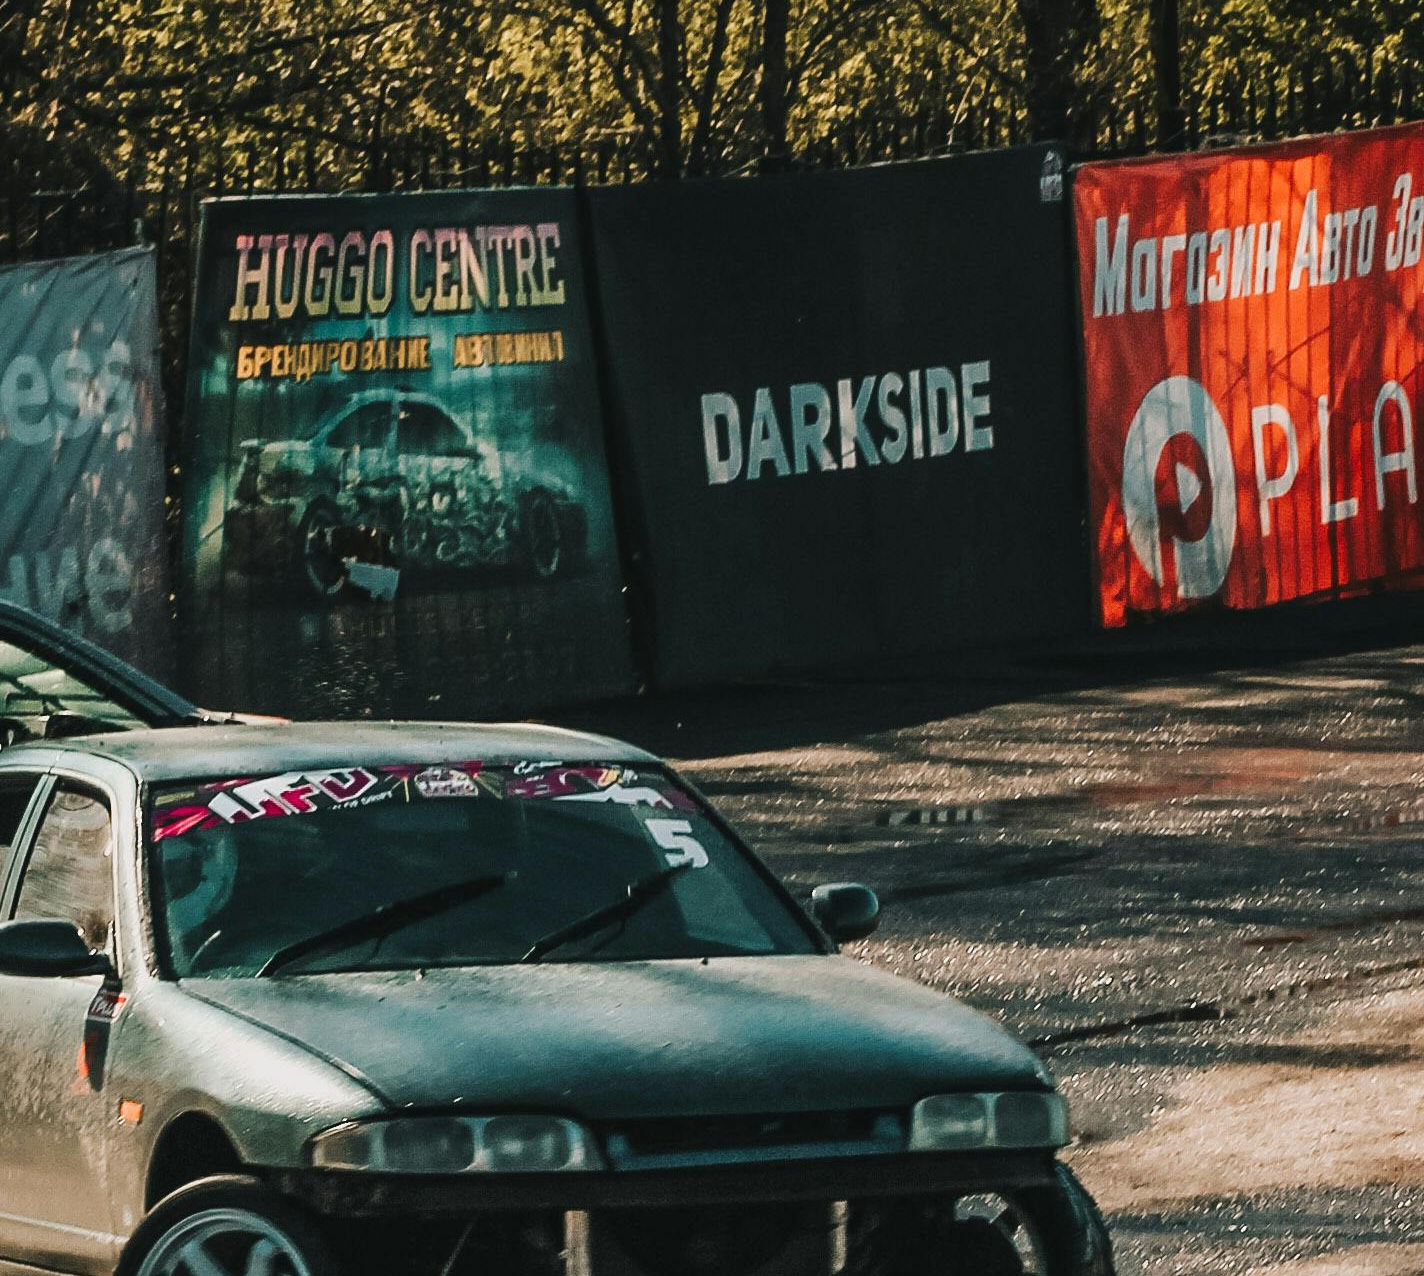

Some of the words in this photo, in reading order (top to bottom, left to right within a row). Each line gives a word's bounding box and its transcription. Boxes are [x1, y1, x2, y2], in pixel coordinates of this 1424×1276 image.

[228, 228, 395, 322] HUGGO
[409, 222, 566, 315] CENTRE
[1092, 212, 1282, 318] Магазин
[1289, 188, 1378, 291] Авто
[236, 336, 432, 384] БРЕНДИРОВАНИЕ
[700, 360, 995, 486] DARKSIDE
[644, 819, 710, 869] 5
